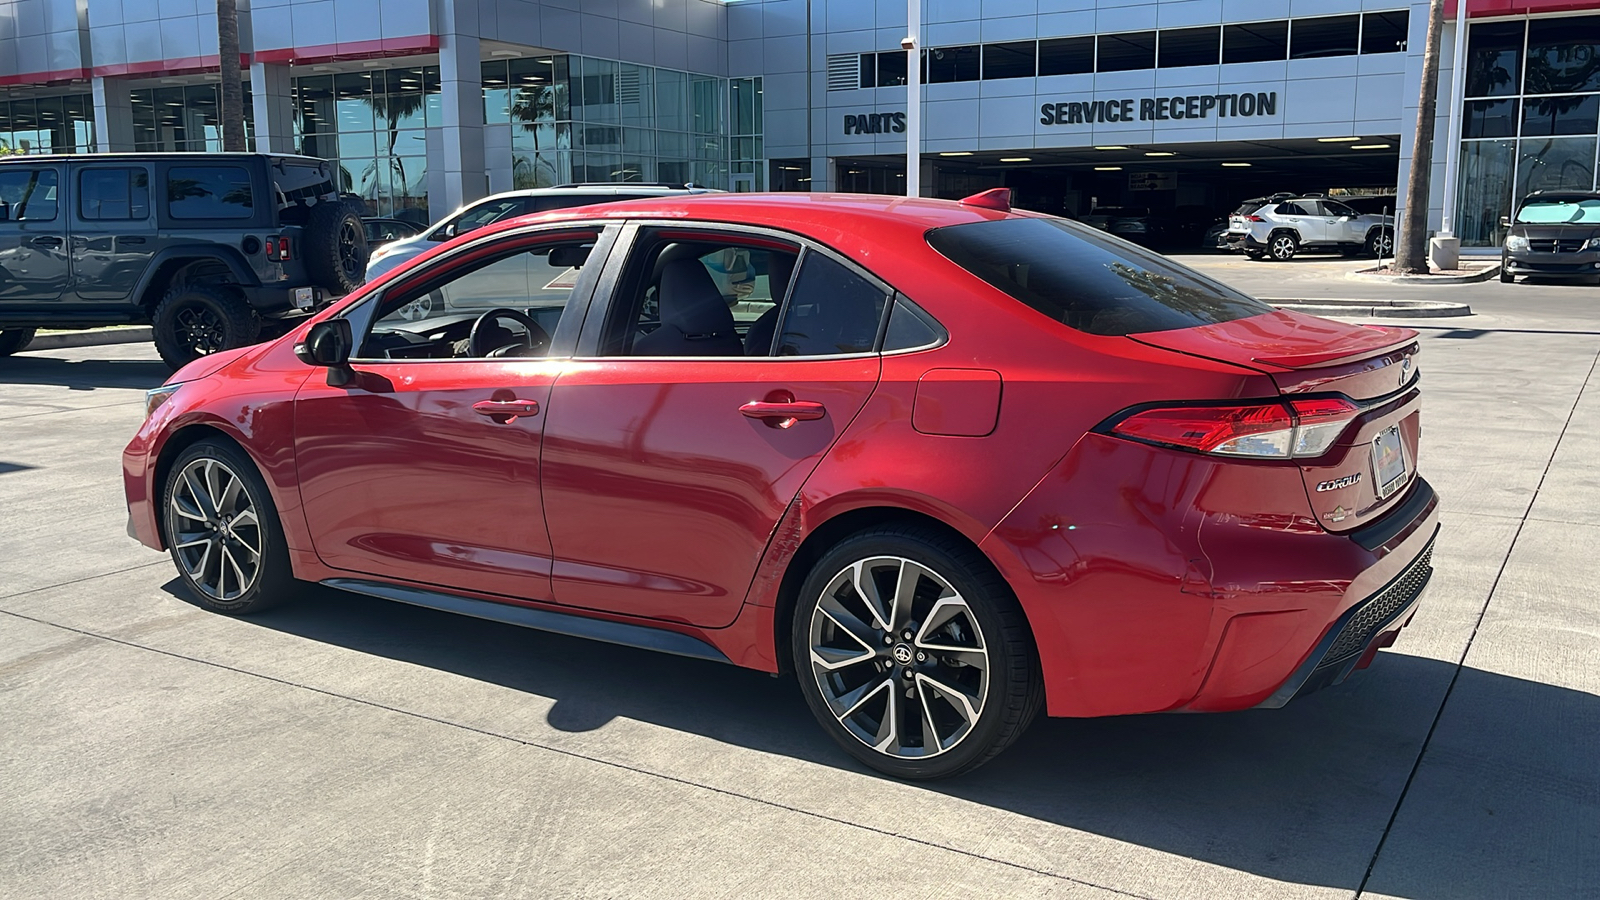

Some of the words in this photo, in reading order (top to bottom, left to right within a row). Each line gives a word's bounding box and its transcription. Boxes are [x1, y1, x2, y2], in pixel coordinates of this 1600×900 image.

[1040, 99, 1134, 125] SERVICE
[1139, 92, 1276, 121] RECEPTION
[844, 112, 906, 135] PARTS
[1315, 472, 1362, 492] COROLLA
